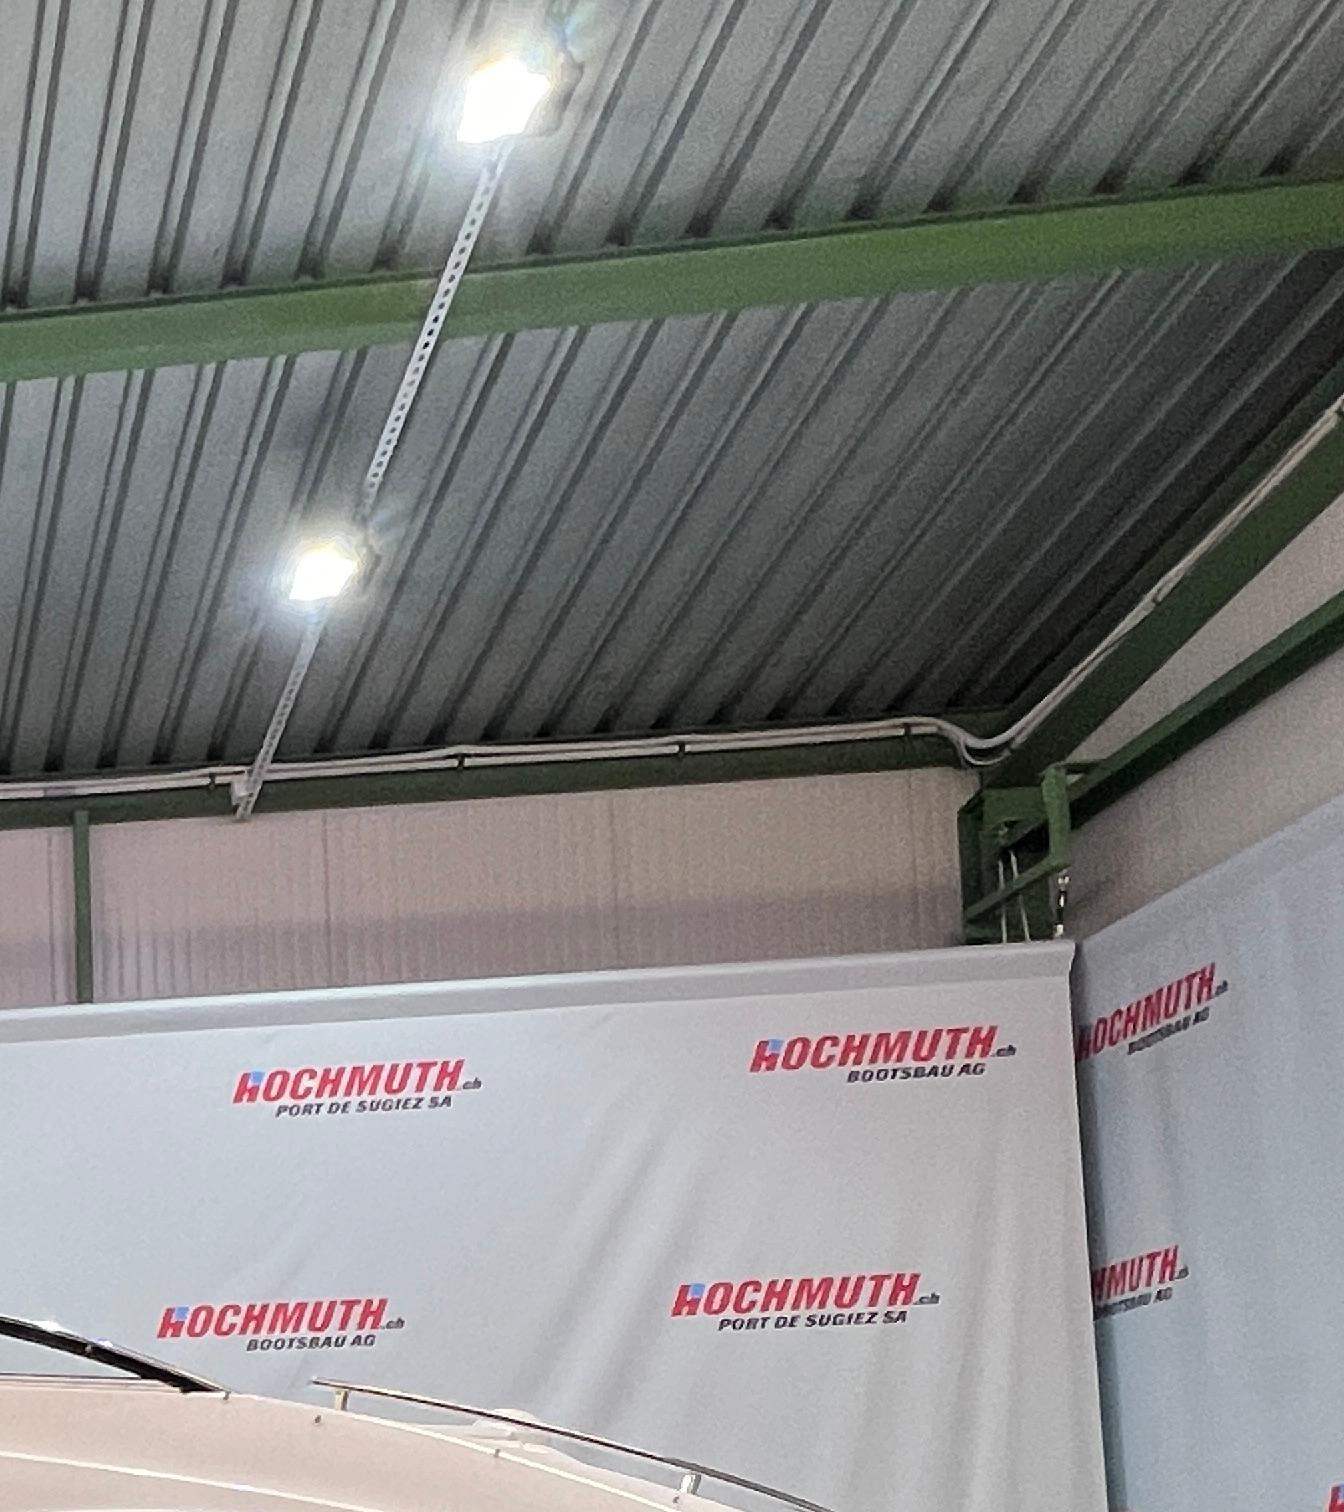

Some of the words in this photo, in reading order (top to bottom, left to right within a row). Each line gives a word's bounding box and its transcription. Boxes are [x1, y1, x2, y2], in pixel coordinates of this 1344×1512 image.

[846, 1065, 955, 1083] BOOTSBAU
[957, 1063, 987, 1077] AG
[275, 1104, 323, 1118] PORT
[326, 1102, 351, 1114] DE
[355, 1097, 424, 1112] SUGIEZ
[427, 1096, 452, 1108] SA
[718, 1317, 770, 1331] PORT
[774, 1315, 800, 1329] DE
[805, 1312, 878, 1327] SUGIEZ
[883, 1310, 908, 1324] SA
[246, 1336, 347, 1351] BOOTSBAU
[350, 1335, 377, 1347] AG
